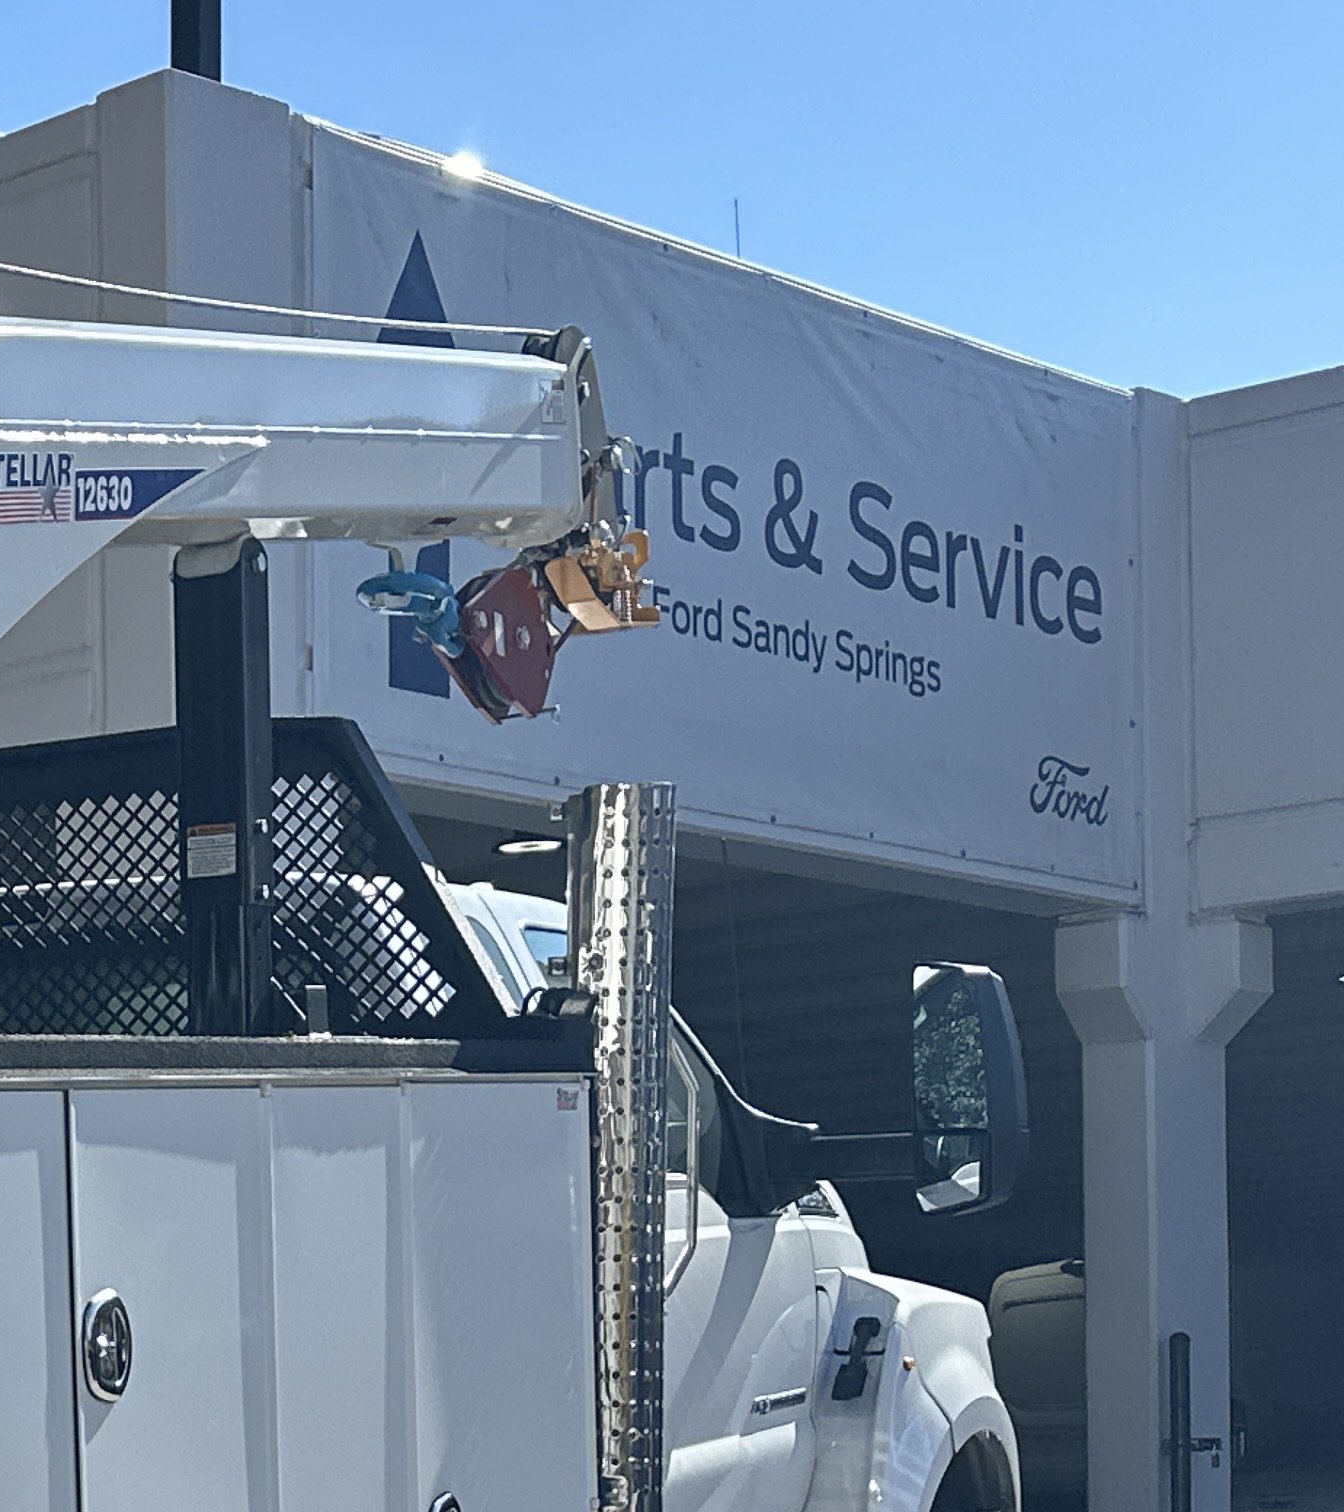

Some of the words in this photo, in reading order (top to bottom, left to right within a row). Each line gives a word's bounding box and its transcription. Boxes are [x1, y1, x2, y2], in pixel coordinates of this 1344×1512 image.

[76, 475, 133, 513] 12630
[614, 432, 741, 553] rts
[763, 457, 824, 575] &
[847, 482, 1105, 645] Service
[653, 584, 723, 643] Ford
[732, 604, 828, 674] Sandy
[834, 629, 943, 698] Springs
[1028, 754, 1110, 828] Ford
